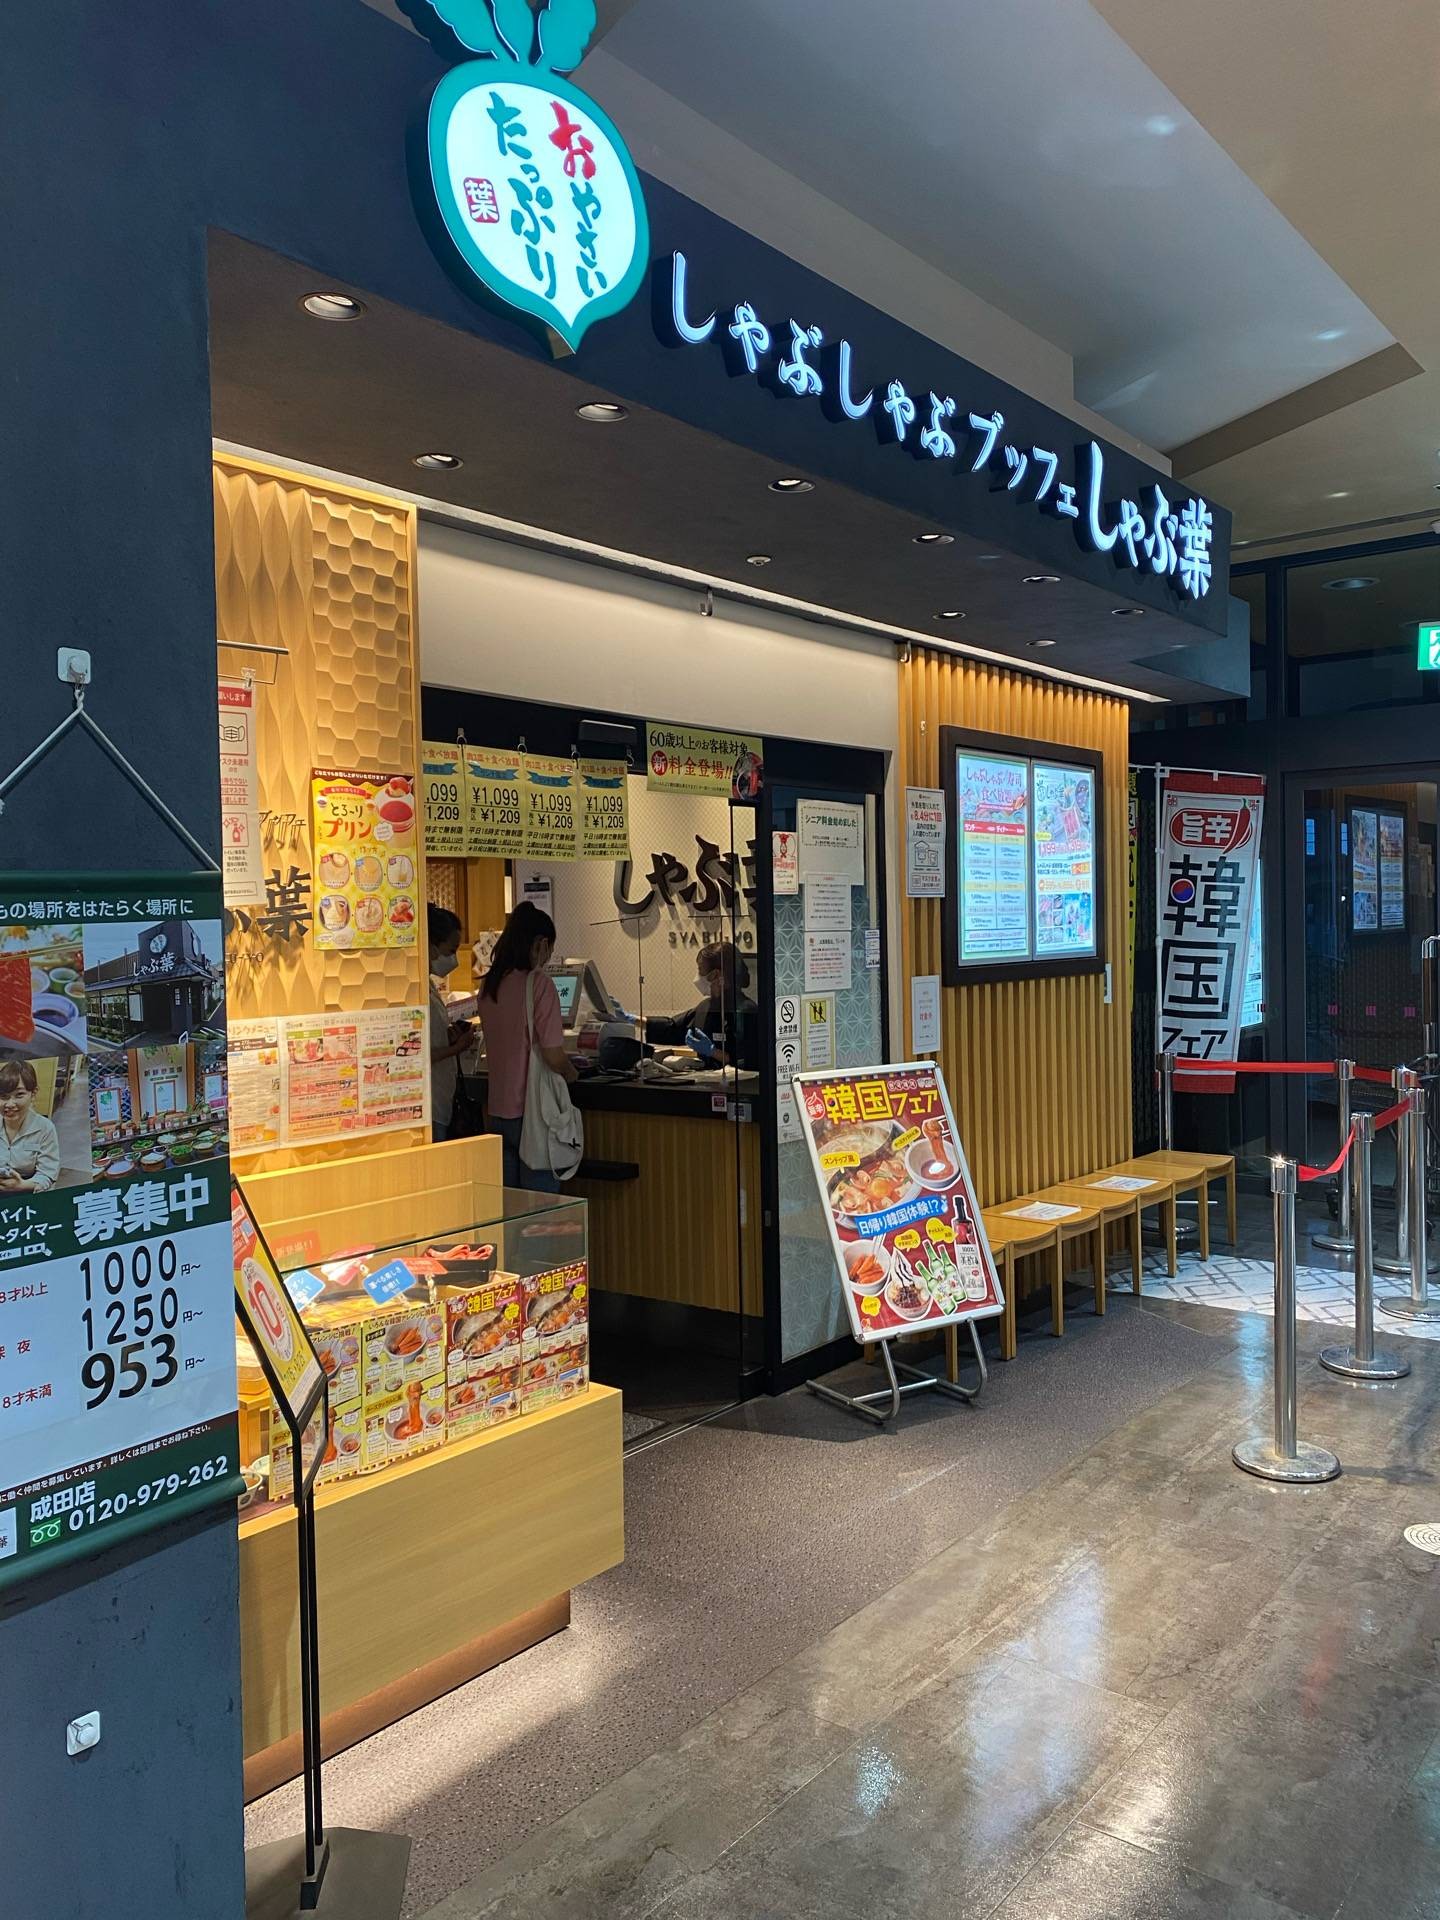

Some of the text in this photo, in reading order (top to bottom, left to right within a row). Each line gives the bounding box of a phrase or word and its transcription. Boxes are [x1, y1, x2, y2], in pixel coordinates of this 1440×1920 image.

[464, 178, 499, 222] 葉
[487, 91, 558, 300] たっぷり
[549, 101, 607, 298] おやさい
[672, 250, 1213, 600] しゃぶしゃぶブッフェ しゃぶ葉
[649, 729, 748, 758] 60歳以上のお客様対象
[472, 786, 519, 807] ¥1,099
[530, 792, 572, 812] ¥1,099
[586, 795, 623, 812] ¥1,099
[323, 818, 372, 841] プリン
[480, 808, 520, 824] ¥1,209
[538, 813, 573, 829] ¥1,209
[592, 815, 624, 829] ¥1,209
[1182, 812, 1232, 843] 旨辛
[613, 834, 758, 915] しゃぶ
[1162, 854, 1245, 1020] 韓国
[778, 1025, 798, 1035] 全席禁煙
[1162, 1027, 1228, 1060] フェア
[777, 1065, 789, 1073] FREE
[73, 1172, 209, 1246] 募集中
[30, 1480, 96, 1523] 成田店
[69, 1455, 228, 1532] 0120-979-262
